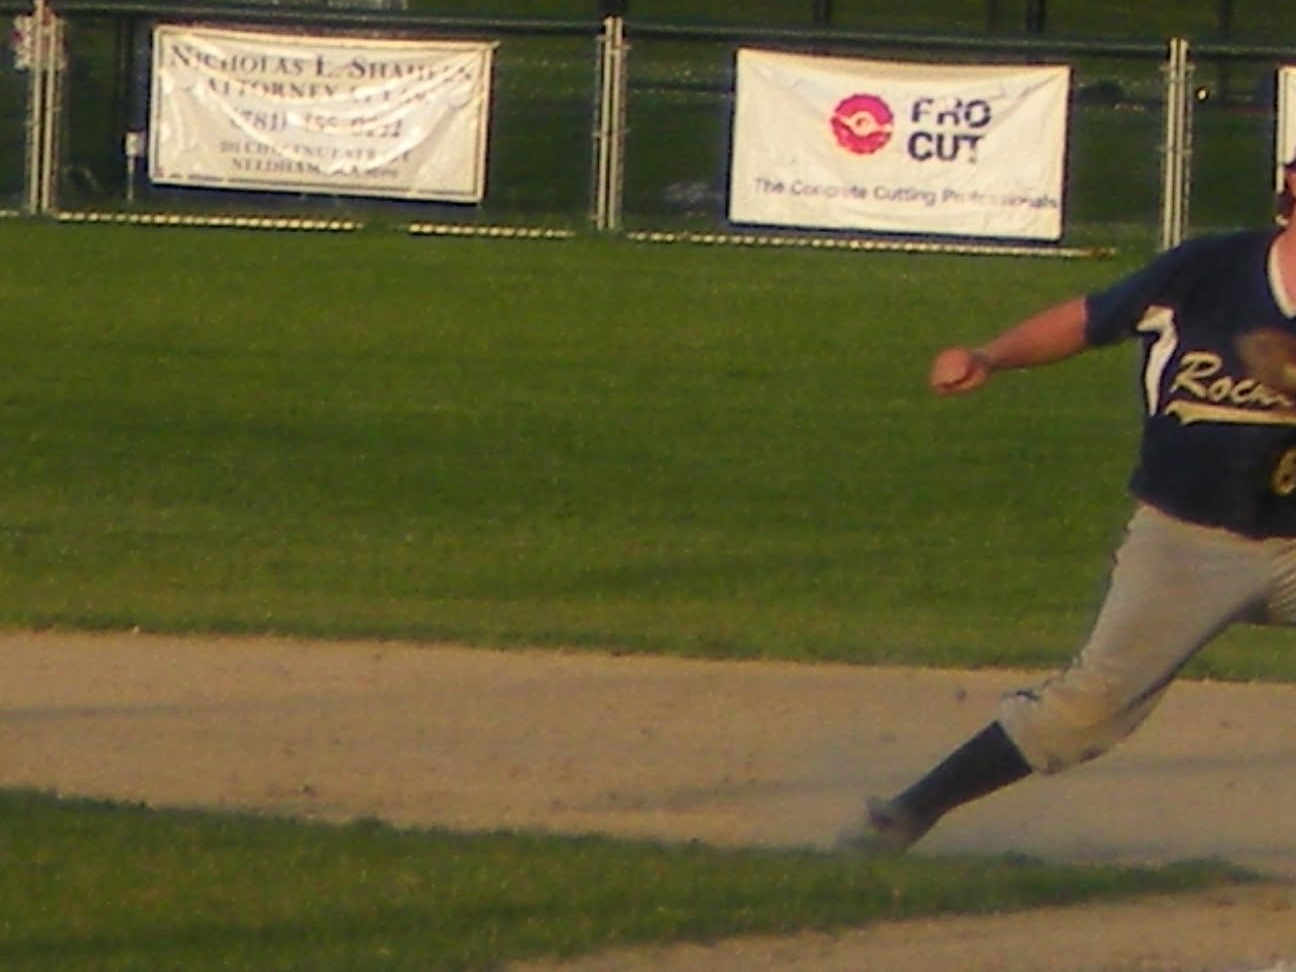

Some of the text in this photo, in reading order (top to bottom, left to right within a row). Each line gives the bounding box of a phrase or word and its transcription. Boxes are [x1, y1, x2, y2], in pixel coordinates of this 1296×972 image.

[908, 131, 985, 165] CUT
[754, 177, 783, 194] The
[874, 185, 935, 207] Cutting
